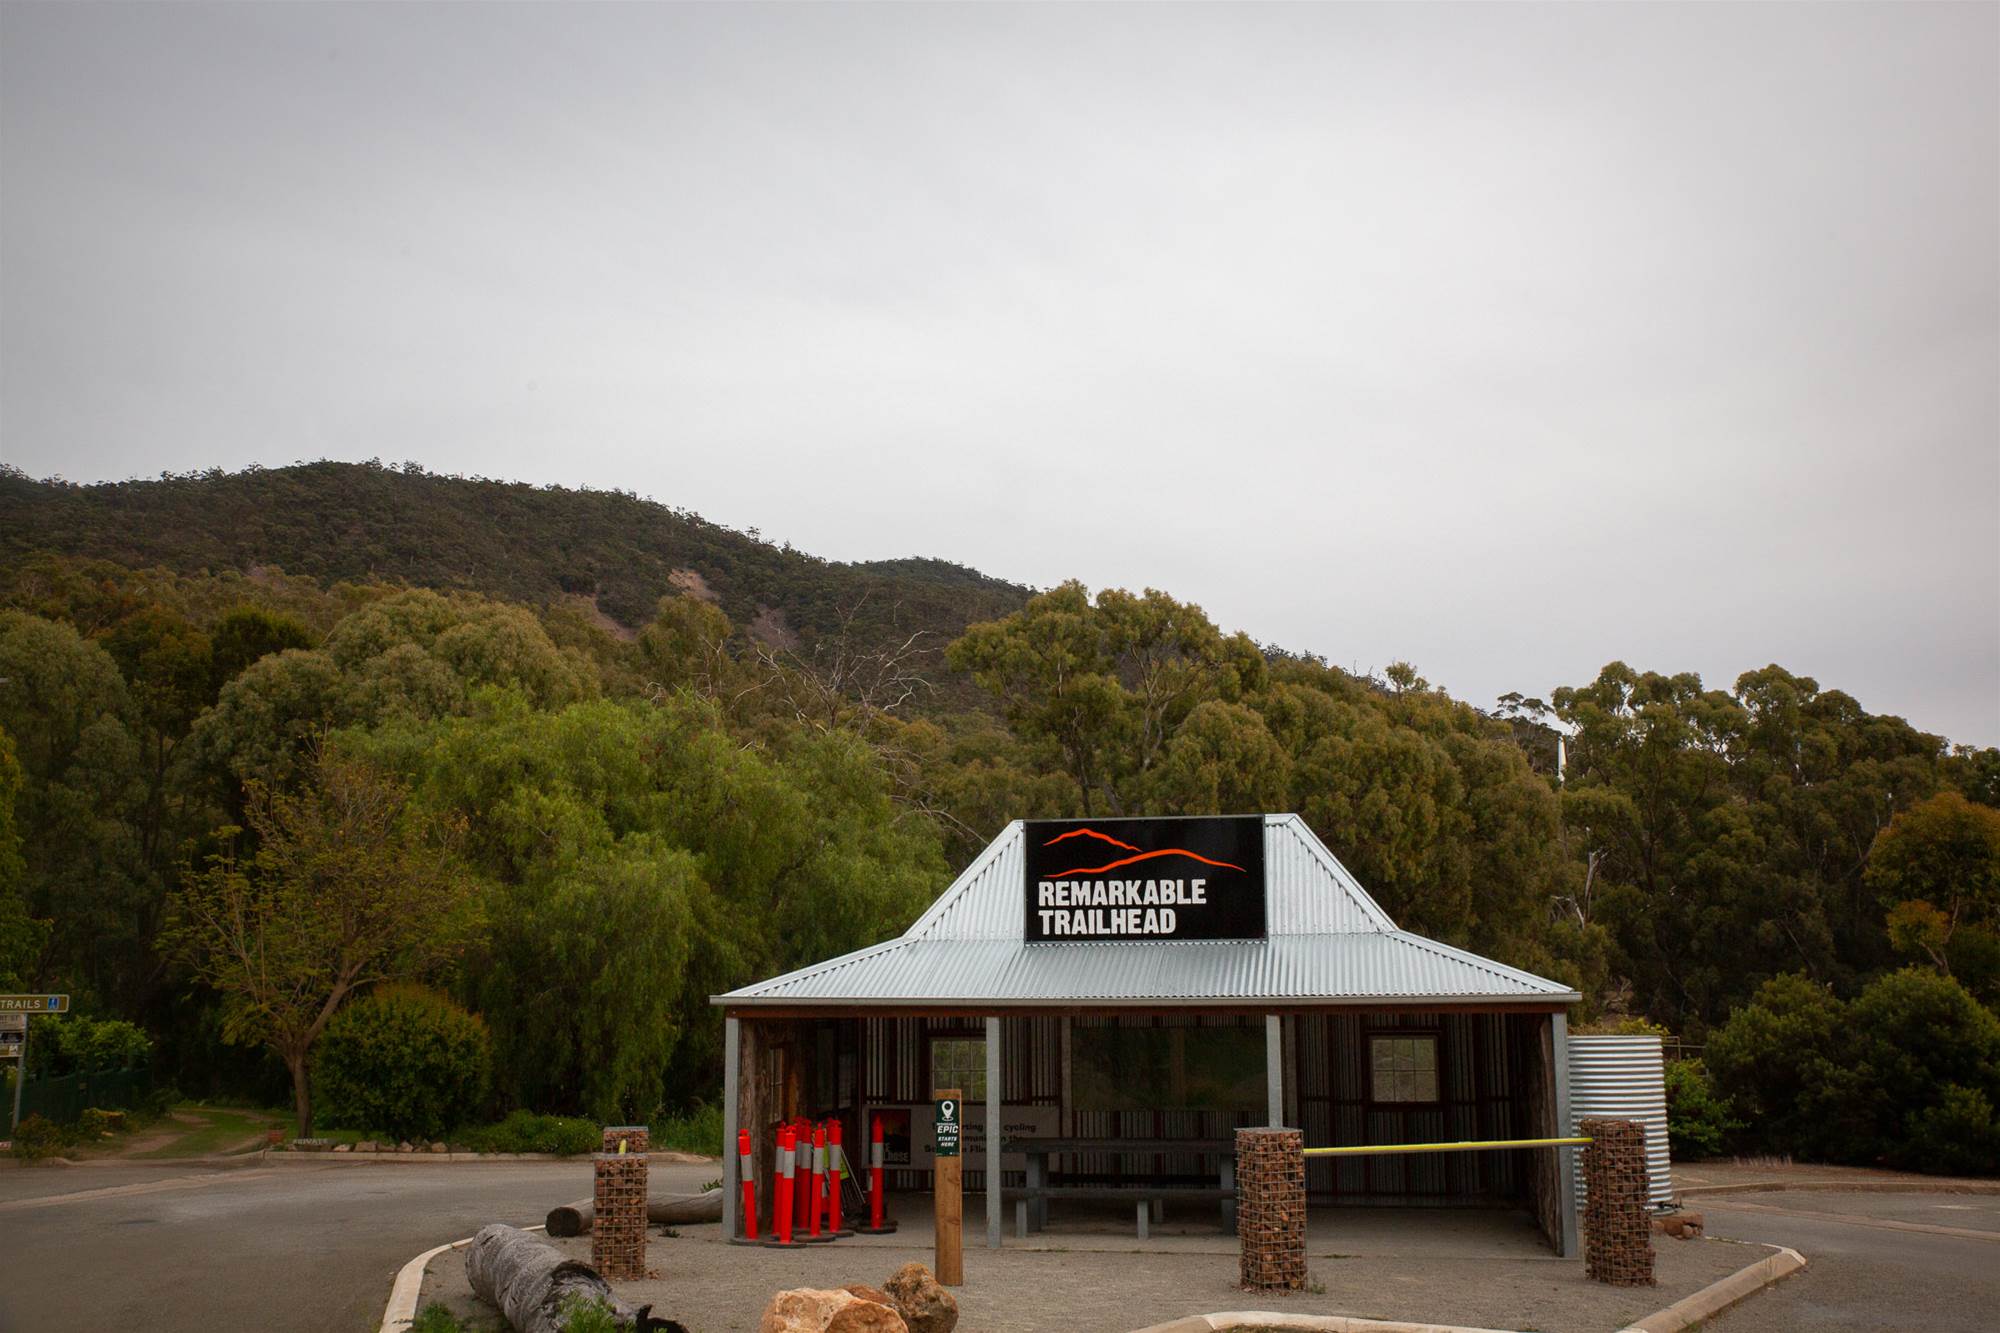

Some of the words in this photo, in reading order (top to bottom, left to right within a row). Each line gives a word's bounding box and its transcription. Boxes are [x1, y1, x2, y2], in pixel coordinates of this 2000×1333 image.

[1038, 878, 1207, 906] REMARKABLE
[1038, 907, 1177, 935] TRAILHEAD
[0, 1000, 41, 1009] TRAILS
[937, 1125, 959, 1134] EPIC
